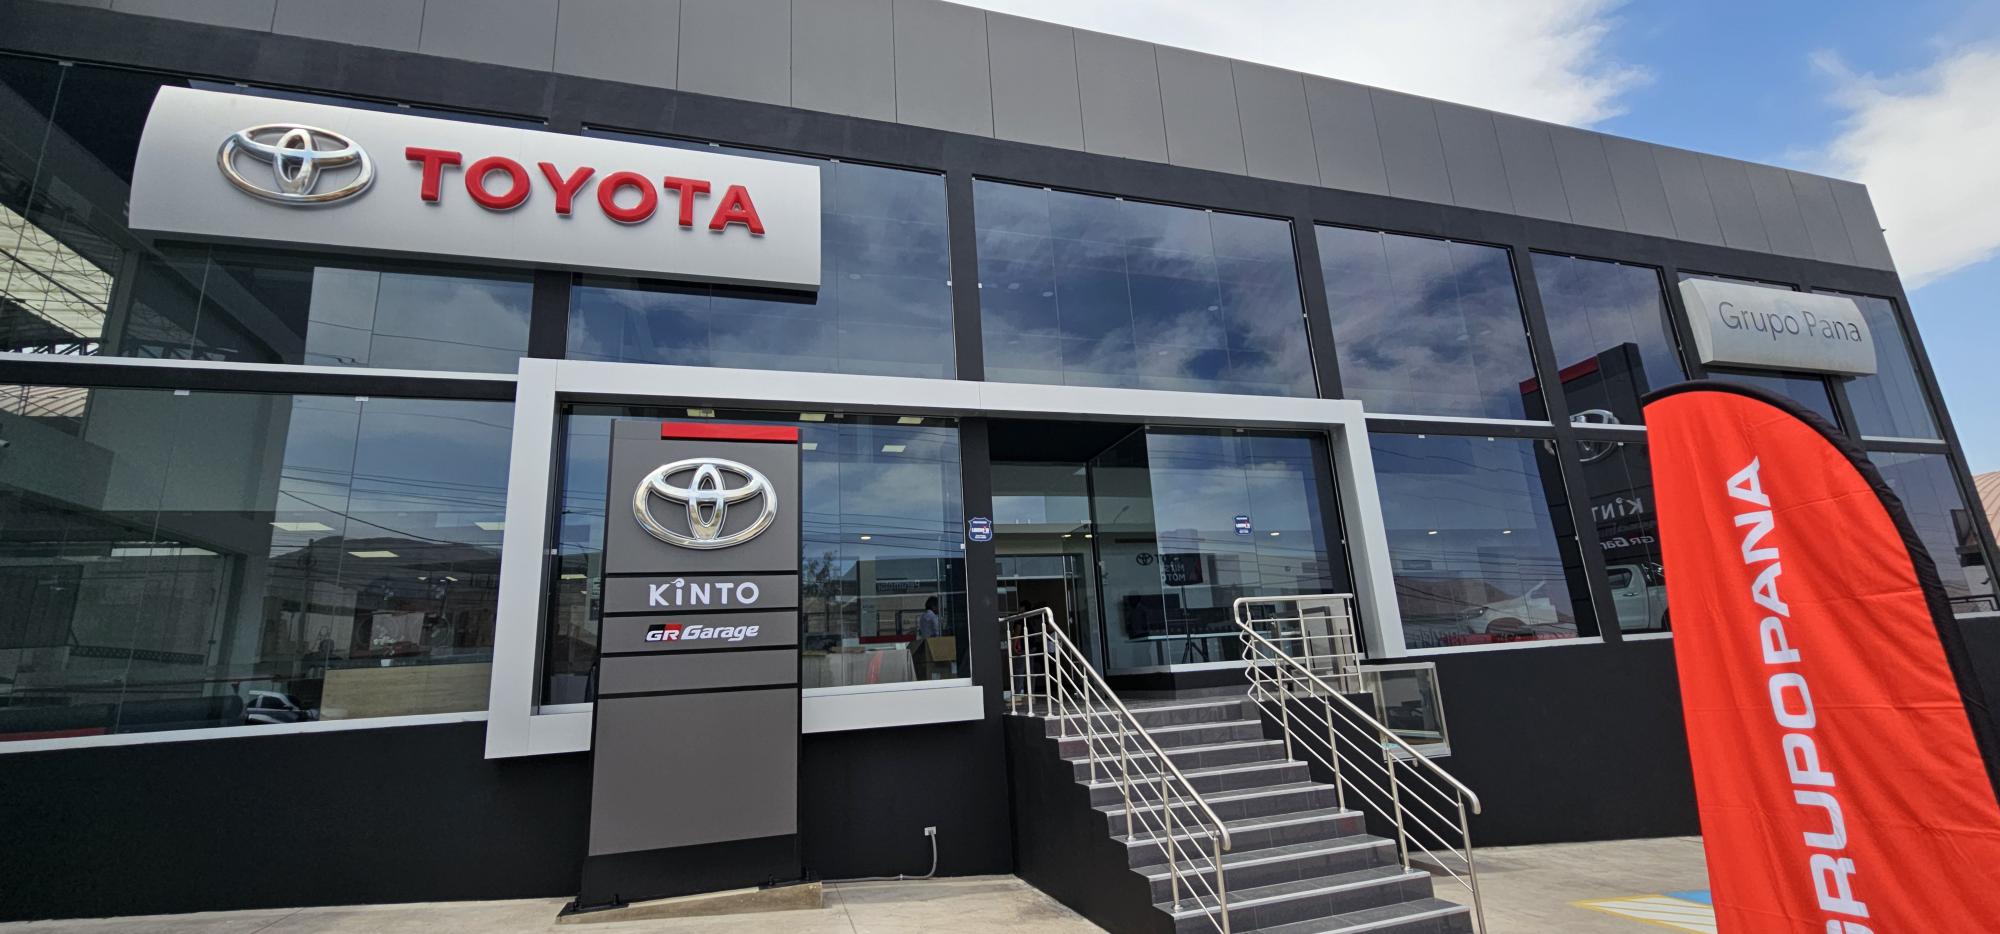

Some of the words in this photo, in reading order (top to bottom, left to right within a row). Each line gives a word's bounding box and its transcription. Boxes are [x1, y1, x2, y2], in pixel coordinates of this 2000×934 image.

[405, 146, 766, 236] TOYOTA
[1718, 301, 1800, 341] Grupo
[1802, 310, 1862, 342] Pana
[645, 629, 680, 641] GR
[681, 625, 759, 641] Garage
